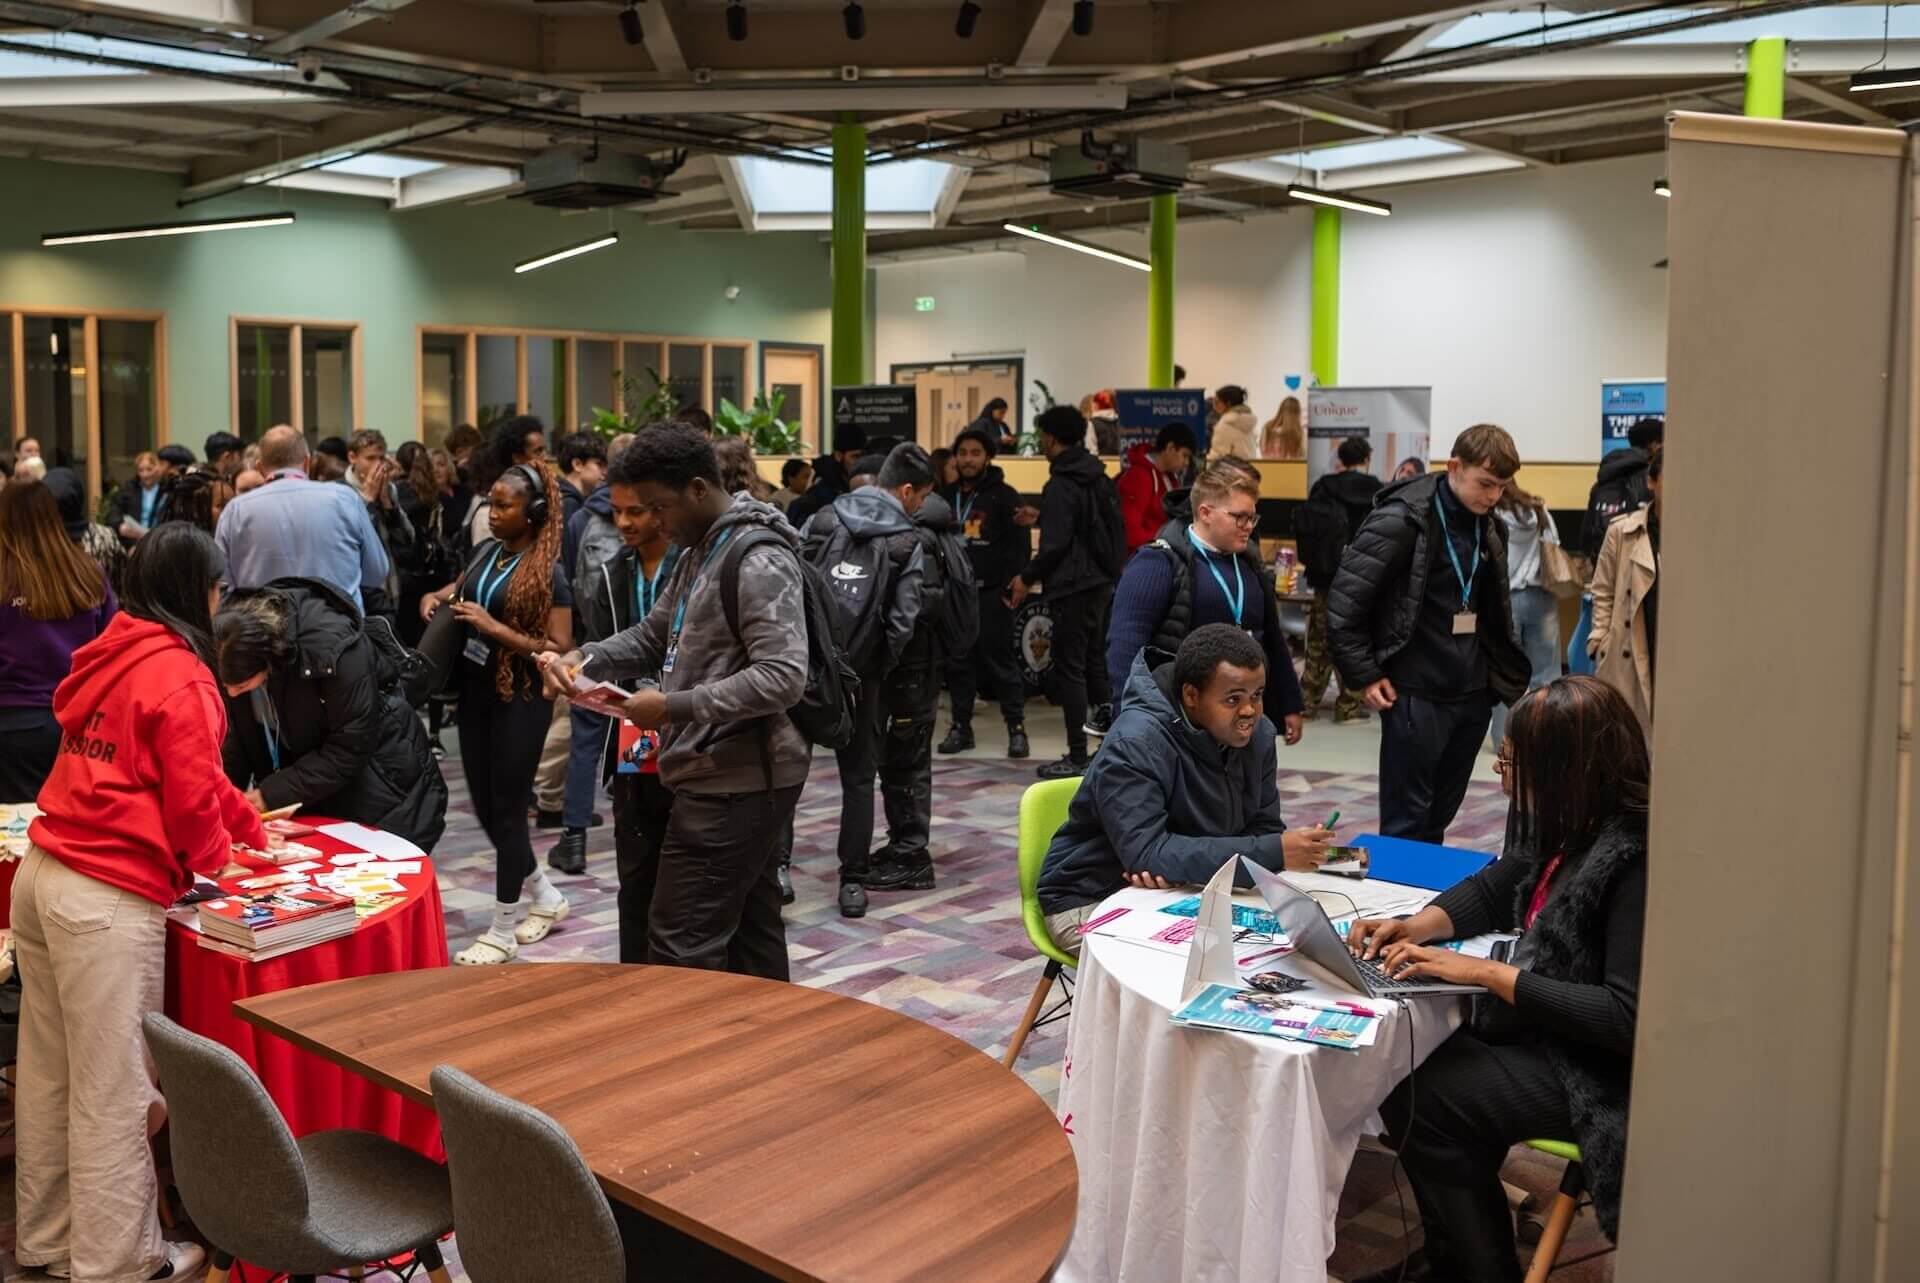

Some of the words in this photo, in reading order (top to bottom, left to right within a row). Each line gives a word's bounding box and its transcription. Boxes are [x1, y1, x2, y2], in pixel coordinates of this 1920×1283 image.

[1152, 406, 1183, 416] POLICE
[1314, 403, 1358, 416] Unique
[832, 579, 859, 595] AIR
